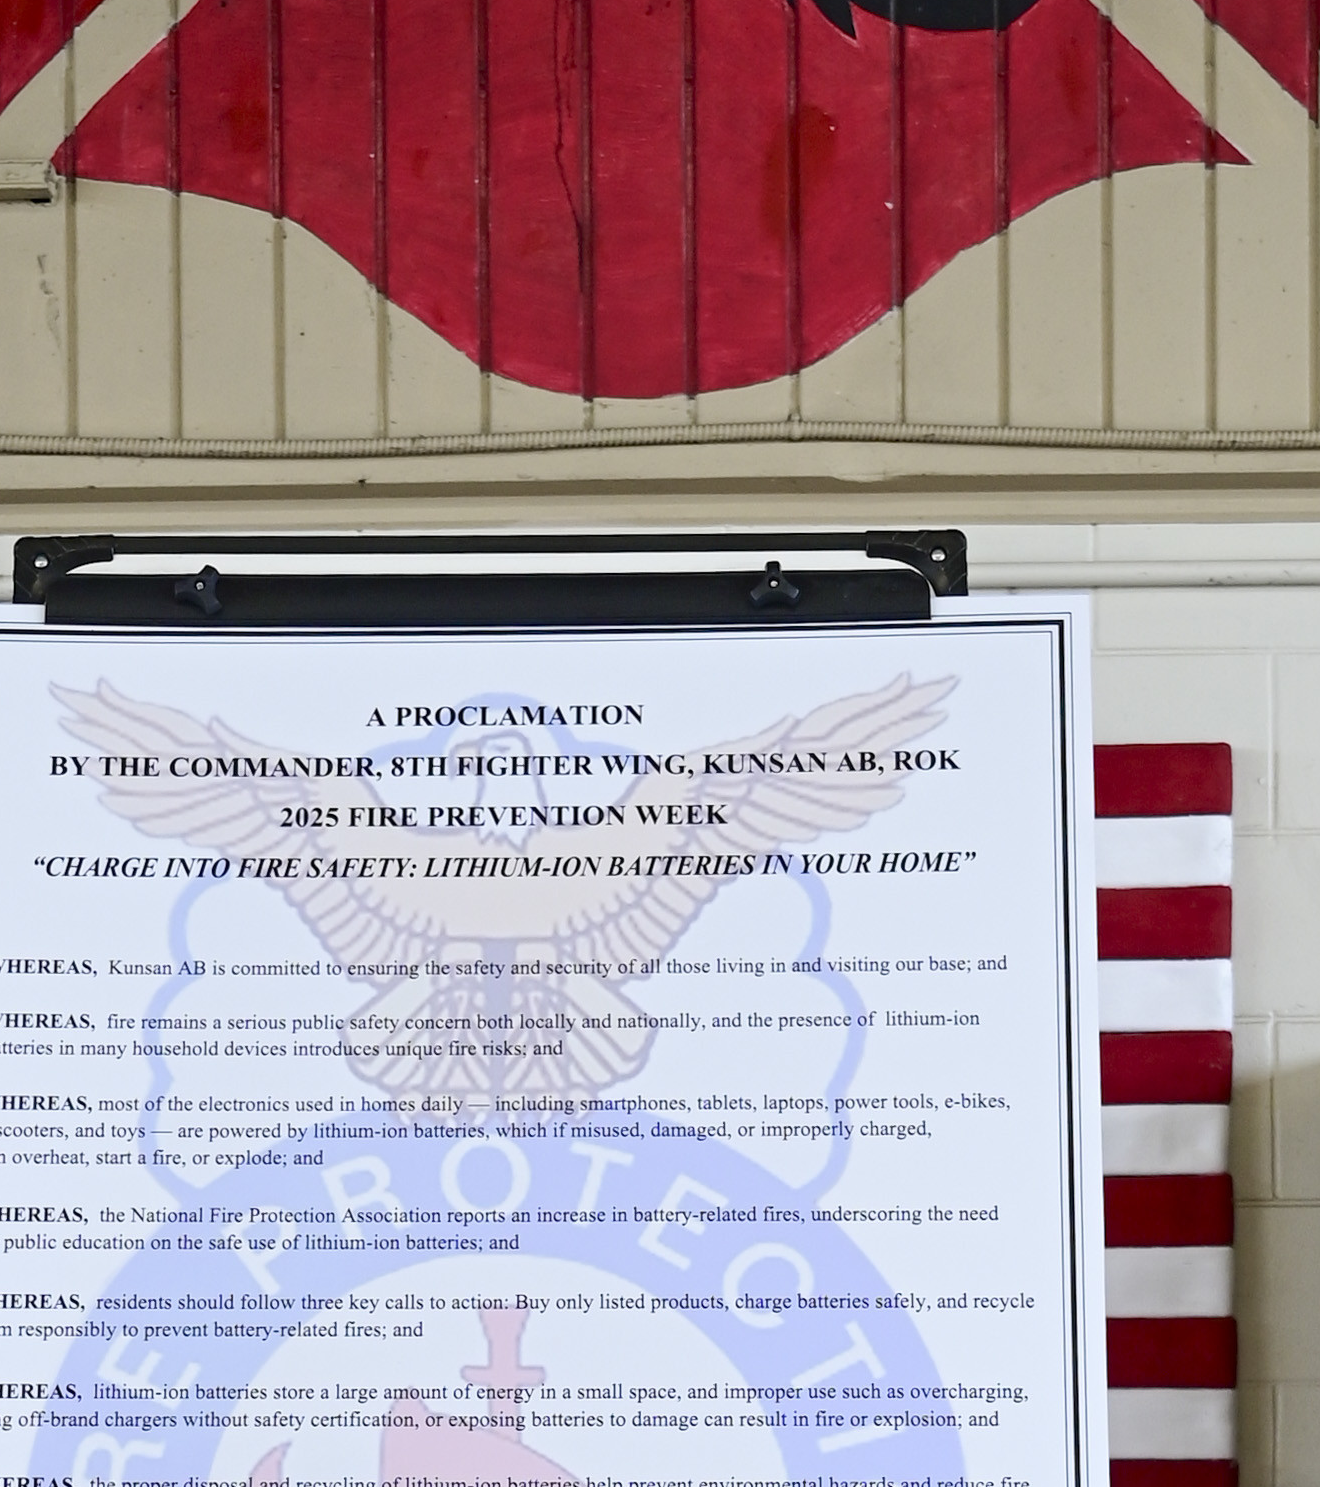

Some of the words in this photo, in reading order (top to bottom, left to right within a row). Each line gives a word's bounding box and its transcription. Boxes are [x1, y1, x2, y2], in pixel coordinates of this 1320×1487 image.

[366, 706, 387, 728] A
[395, 704, 644, 728] PROCLAMATION
[49, 755, 90, 777] BY
[98, 755, 161, 778] THE
[169, 756, 383, 782] COMMANDER,
[390, 756, 448, 778] 8TH
[456, 753, 593, 778] FIGHTER
[601, 753, 695, 780] WING,
[702, 751, 827, 775] KUNSAN
[836, 751, 885, 777] AB,
[893, 749, 961, 772] ROK
[279, 806, 339, 829] 2025
[348, 803, 418, 828] FIRE
[427, 803, 626, 827] PREVENTION
[635, 803, 728, 826] WEEK
[34, 855, 159, 879] “CHARGE
[163, 856, 231, 879] INTO
[236, 857, 301, 882] FIRE
[307, 857, 417, 882] SAFETY:
[423, 855, 602, 878] LITHIUM-ION
[606, 853, 757, 877] BATTERIES
[761, 853, 794, 876] IN
[800, 852, 872, 875] YOUR
[878, 850, 977, 874] HOME”
[108, 959, 172, 976] Kunsan
[177, 960, 206, 976] AB
[212, 959, 226, 976] is
[231, 959, 321, 976] committed
[326, 959, 343, 976] to
[347, 959, 420, 980] ensuring
[425, 957, 451, 976] the
[455, 959, 506, 980] safety
[510, 959, 541, 976] and
[545, 958, 613, 979] security
[617, 958, 638, 975] of
[640, 957, 661, 974] all
[666, 957, 711, 975] those
[716, 957, 765, 978] living
[770, 957, 787, 974] in
[791, 956, 822, 973] and
[827, 955, 891, 977] visiting
[895, 960, 924, 972] our
[928, 955, 972, 974] base;
[977, 954, 1008, 971] and
[96, 1293, 172, 1311] residents
[177, 1293, 235, 1311] should
[240, 1293, 296, 1311] follow
[301, 1293, 344, 1311] three
[348, 1293, 380, 1315] key
[384, 1293, 424, 1311] calls
[429, 1293, 446, 1311] to
[451, 1293, 509, 1311] action:
[514, 1293, 551, 1314] Buy
[555, 1293, 594, 1314] only
[599, 1292, 646, 1310] listed
[650, 1293, 730, 1314] products,
[734, 1292, 792, 1314] charge
[797, 1292, 870, 1310] batteries
[875, 1292, 931, 1313] safely,
[936, 1292, 968, 1309] and
[973, 1291, 1035, 1313] recycle
[18, 1320, 117, 1342] responsibly
[122, 1323, 139, 1338] to
[143, 1323, 208, 1342] prevent
[213, 1320, 338, 1342] battery-related
[344, 1320, 387, 1341] fires;
[392, 1320, 424, 1338] and
